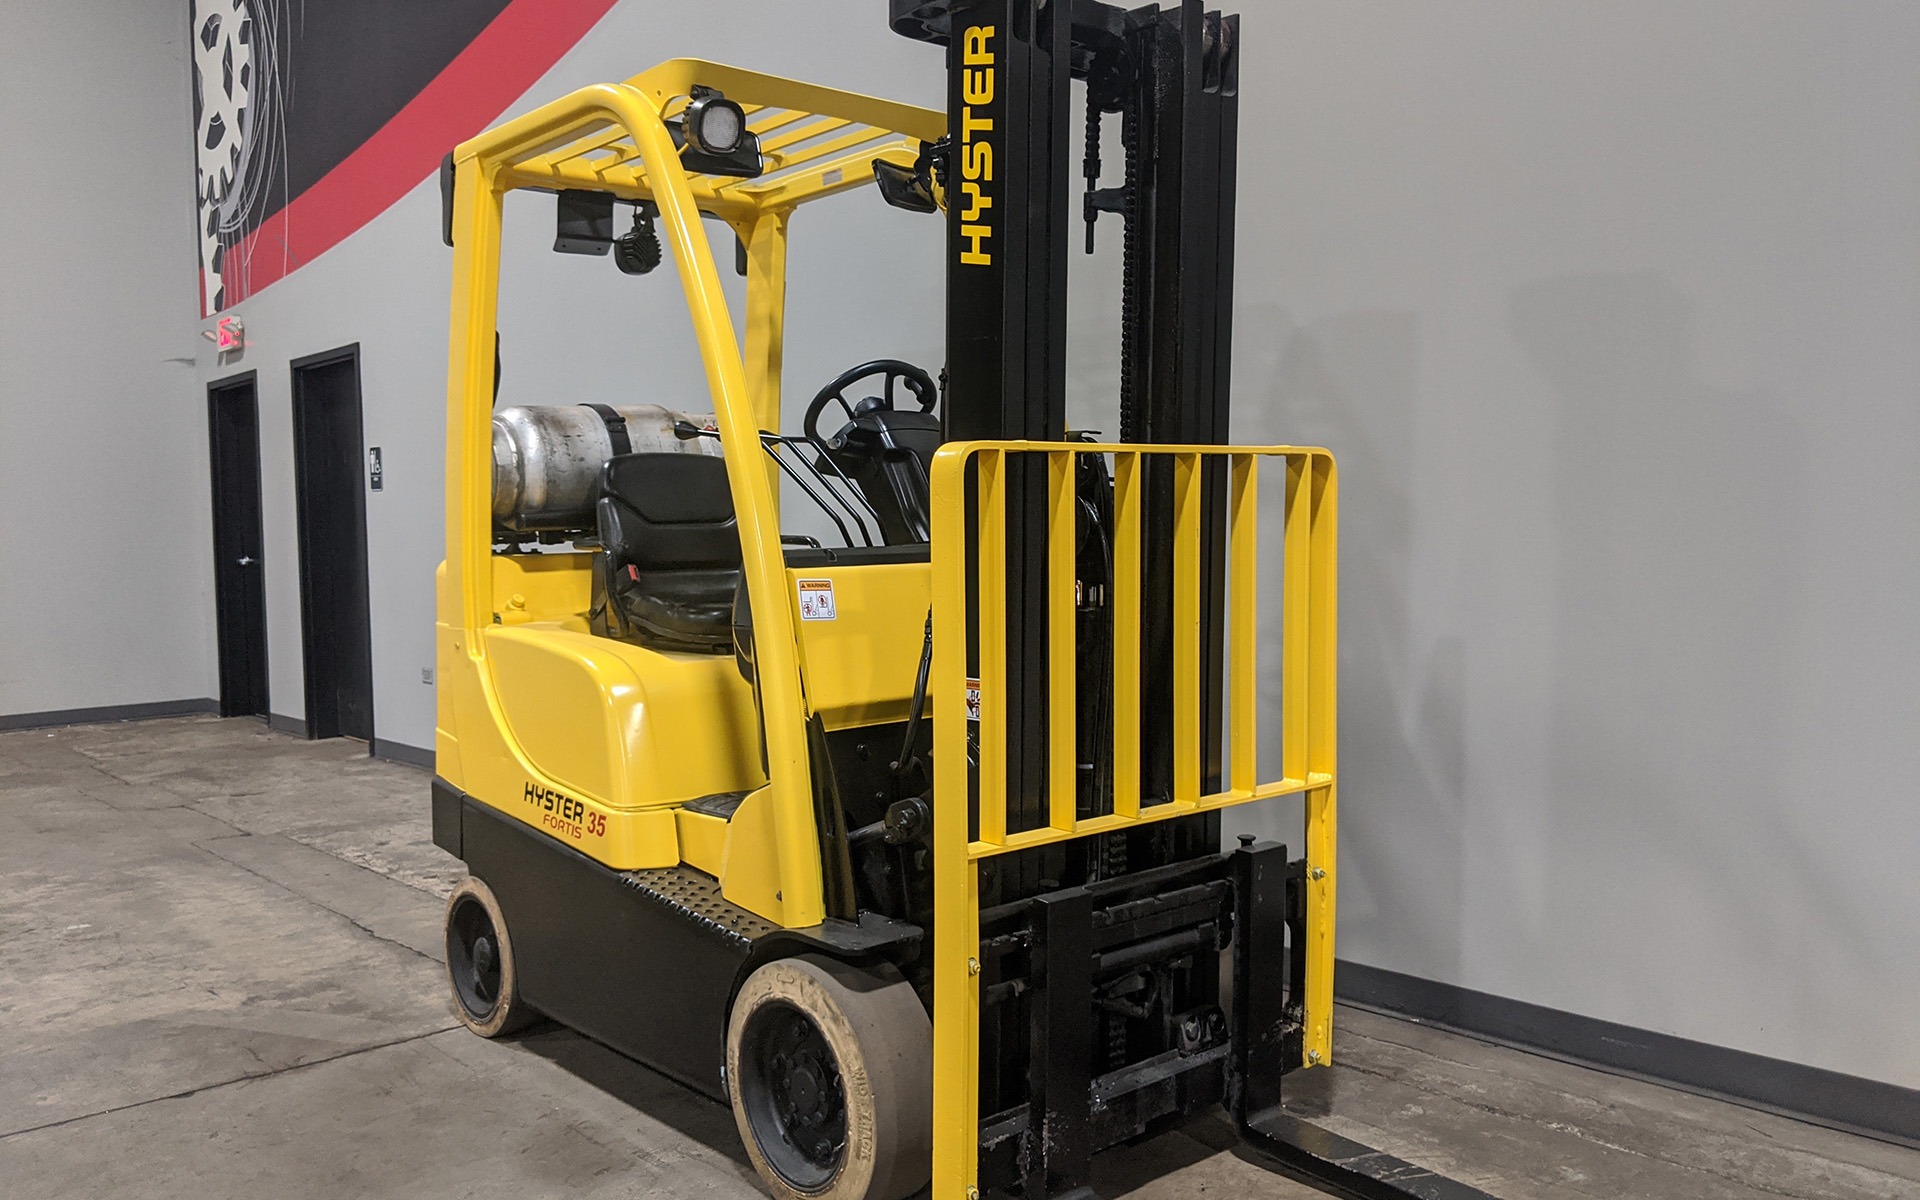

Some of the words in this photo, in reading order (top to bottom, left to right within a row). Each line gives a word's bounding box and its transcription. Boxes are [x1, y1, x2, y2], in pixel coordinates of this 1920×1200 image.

[960, 25, 995, 266] HYSTER
[524, 781, 584, 824] HYSTER
[587, 811, 607, 837] 35
[542, 814, 582, 839] FORTIS
